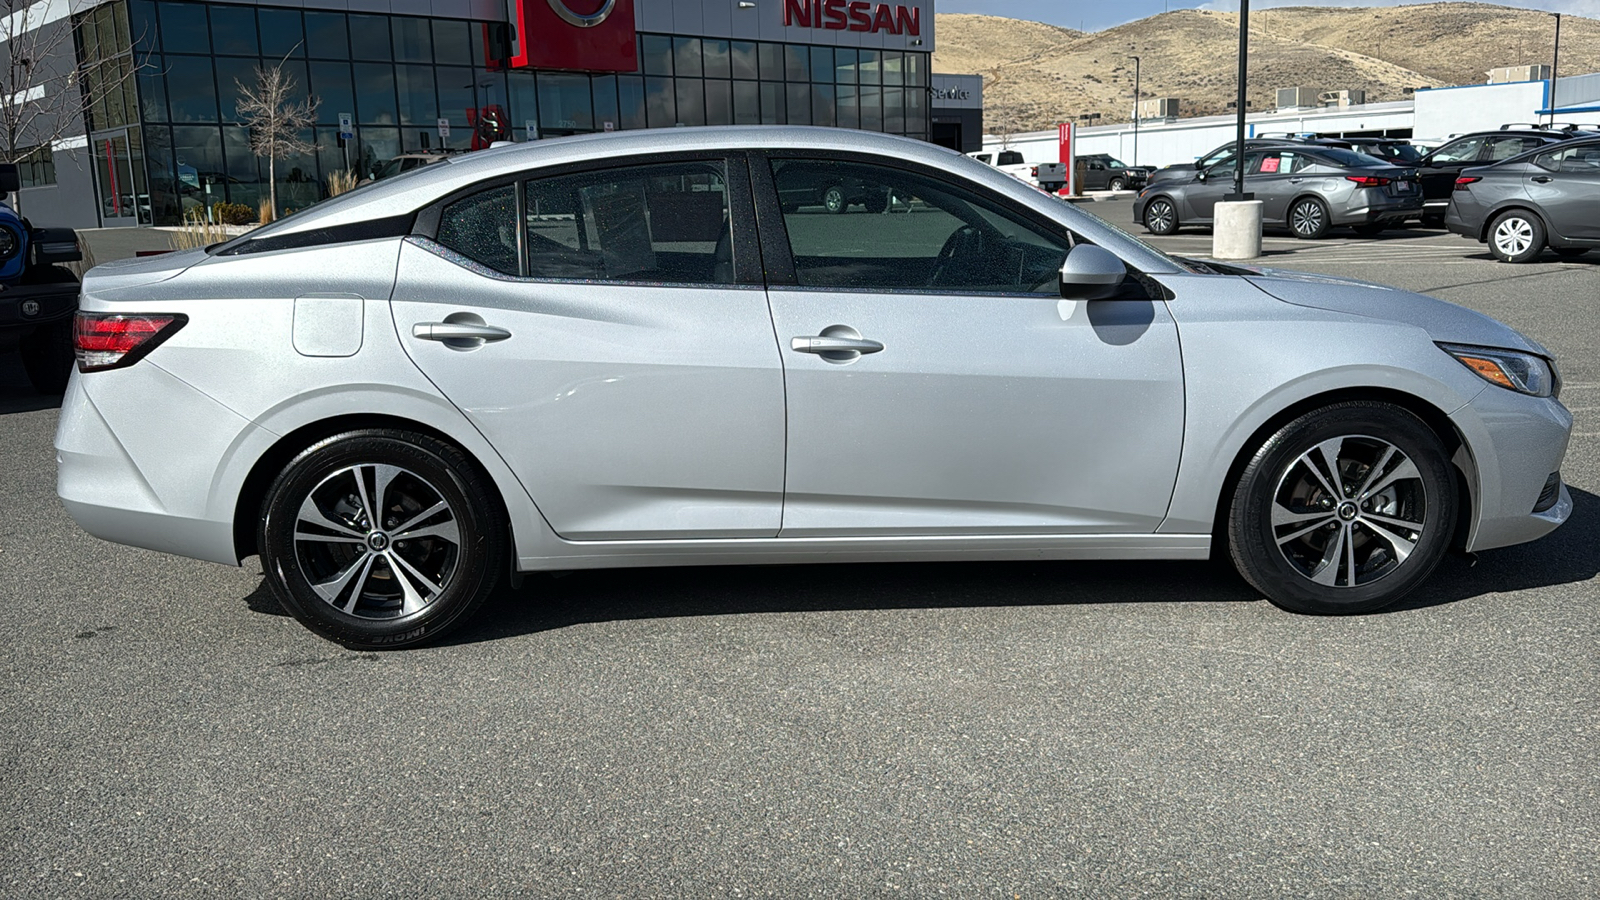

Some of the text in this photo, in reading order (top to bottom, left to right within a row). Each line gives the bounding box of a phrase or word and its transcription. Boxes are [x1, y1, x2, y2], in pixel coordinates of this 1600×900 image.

[784, 0, 920, 36] NISSAN
[930, 85, 971, 100] Service
[558, 119, 577, 128] 2750
